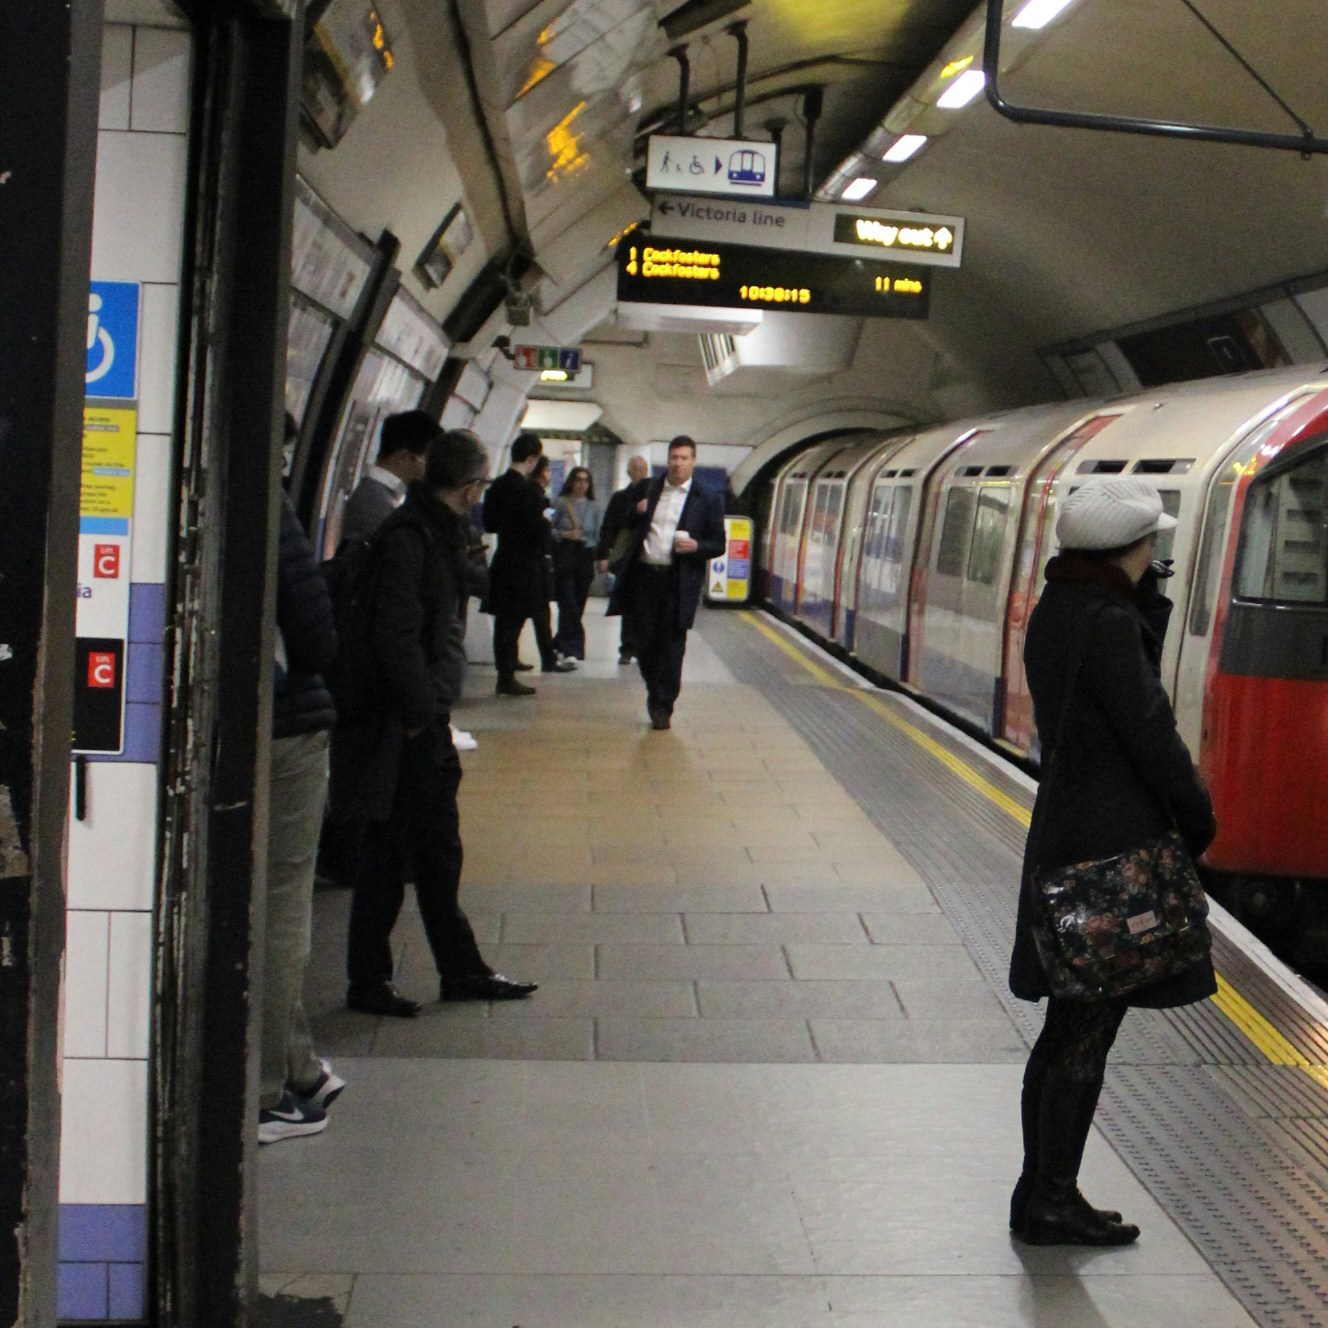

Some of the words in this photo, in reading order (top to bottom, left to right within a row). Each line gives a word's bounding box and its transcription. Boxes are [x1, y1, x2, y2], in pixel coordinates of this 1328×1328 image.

[678, 202, 746, 223] Victoria
[753, 212, 785, 228] line
[856, 218, 898, 246] Way
[898, 226, 934, 248] out
[629, 246, 637, 261] 1
[643, 247, 721, 267] Cockfosters
[626, 260, 638, 275] 4
[642, 261, 720, 280] Cockfosters
[874, 276, 890, 292] 11
[893, 278, 923, 294] mins
[98, 556, 115, 574] C
[94, 664, 111, 683] C
